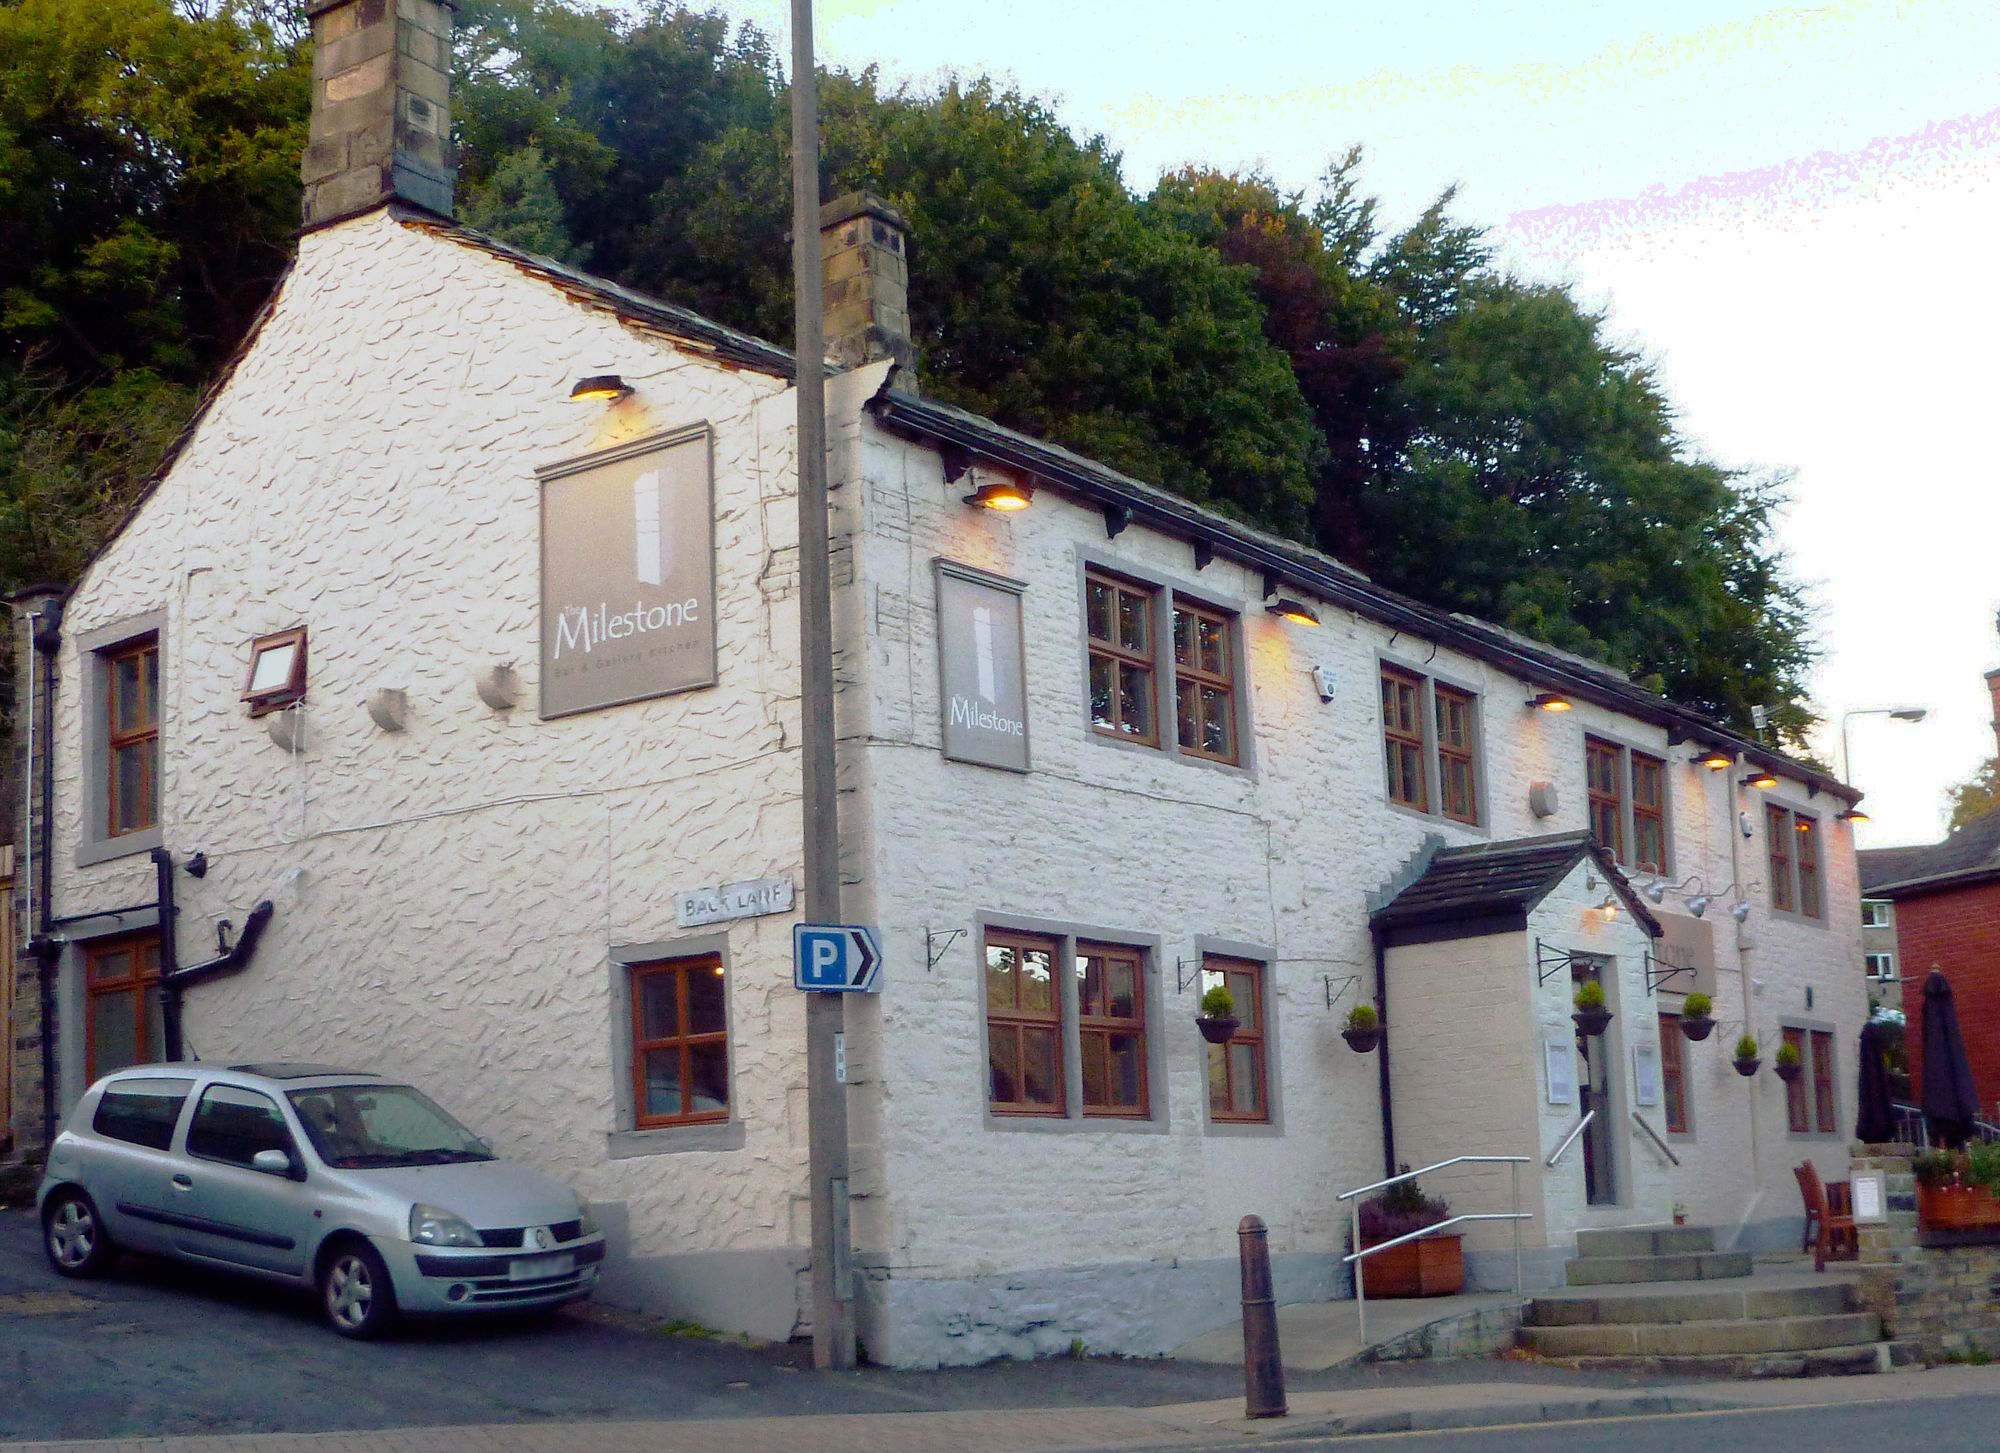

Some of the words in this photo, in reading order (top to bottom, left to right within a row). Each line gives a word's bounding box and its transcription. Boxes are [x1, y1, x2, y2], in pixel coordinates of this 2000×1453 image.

[553, 598, 698, 660] Milestone
[950, 696, 1023, 736] Milestone
[813, 939, 838, 978] P
